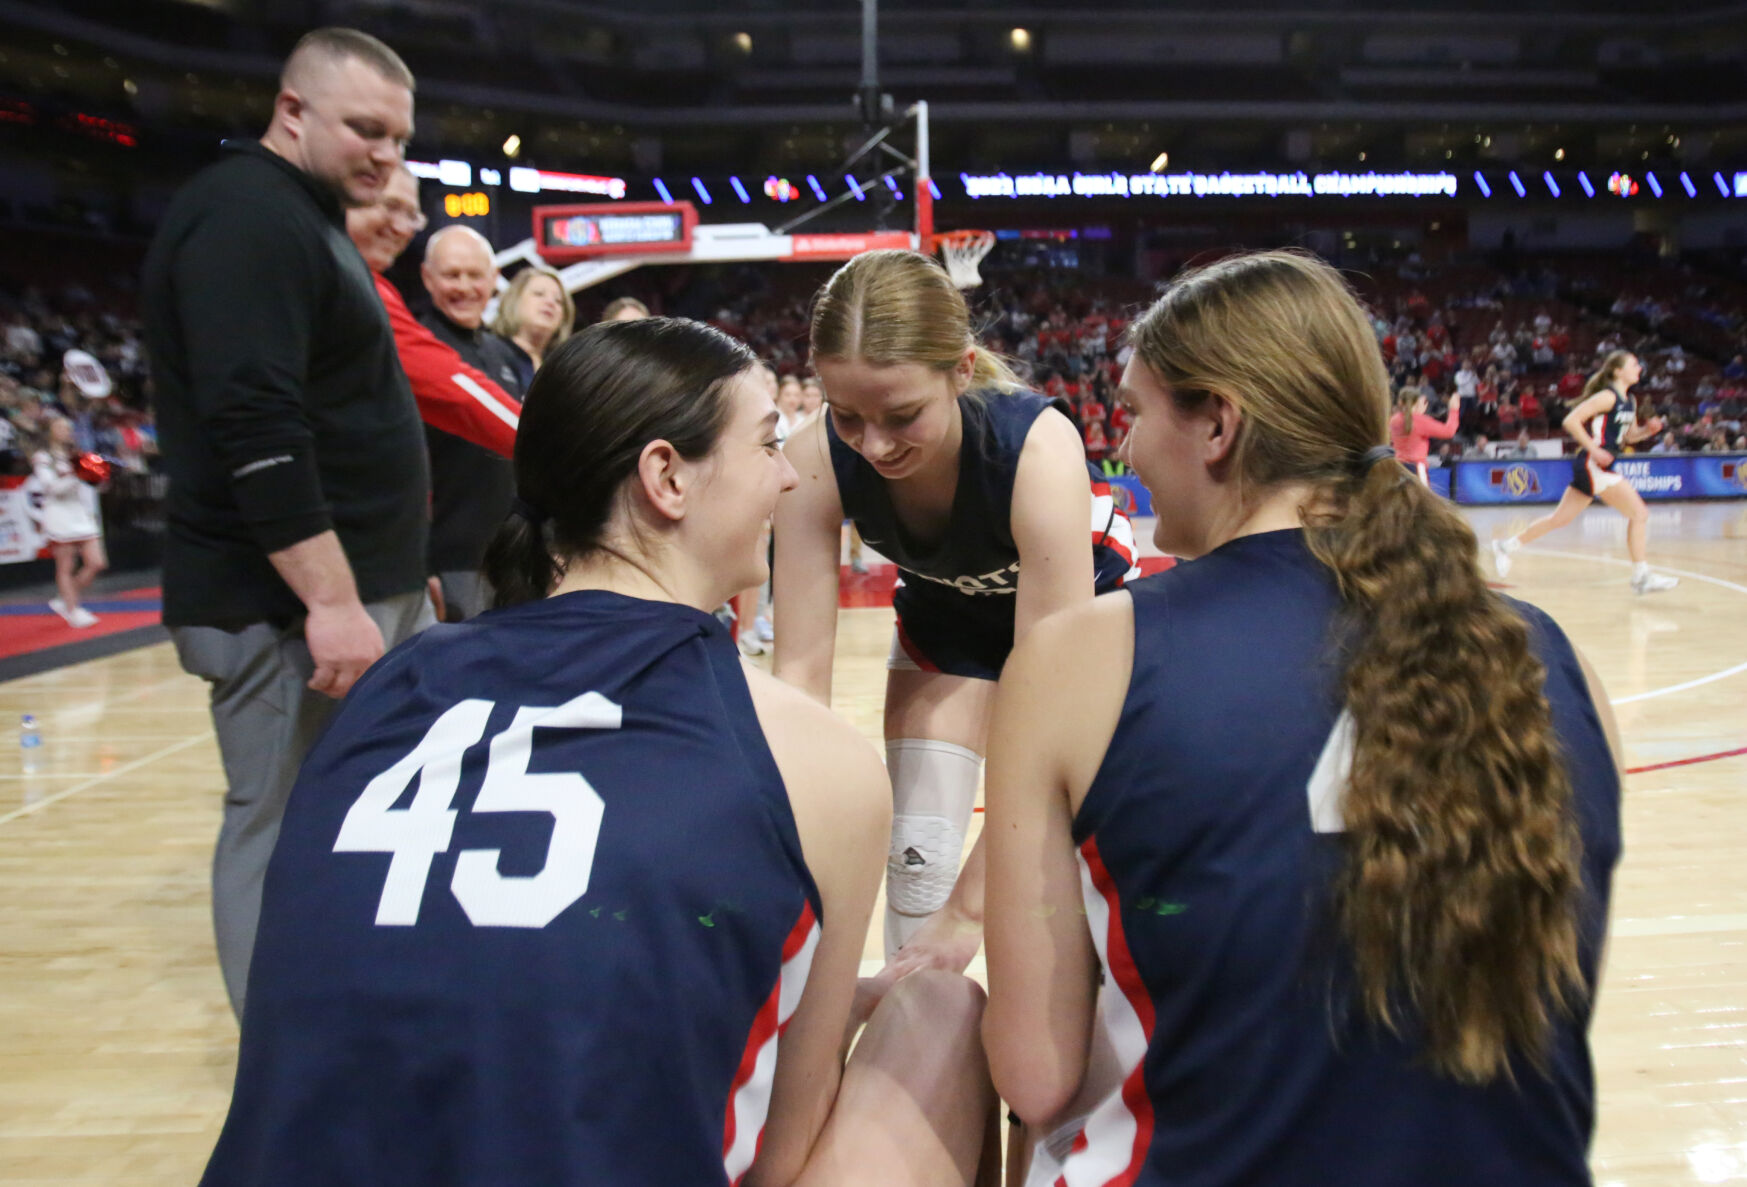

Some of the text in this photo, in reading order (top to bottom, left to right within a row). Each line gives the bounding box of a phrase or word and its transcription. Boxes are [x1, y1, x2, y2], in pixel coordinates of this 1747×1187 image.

[1129, 175, 1191, 194] STATE
[1193, 174, 1311, 195] BASKETBALL
[1614, 461, 1651, 475] STATE
[1630, 475, 1682, 491] ONSHIPS
[332, 691, 622, 928] 45
